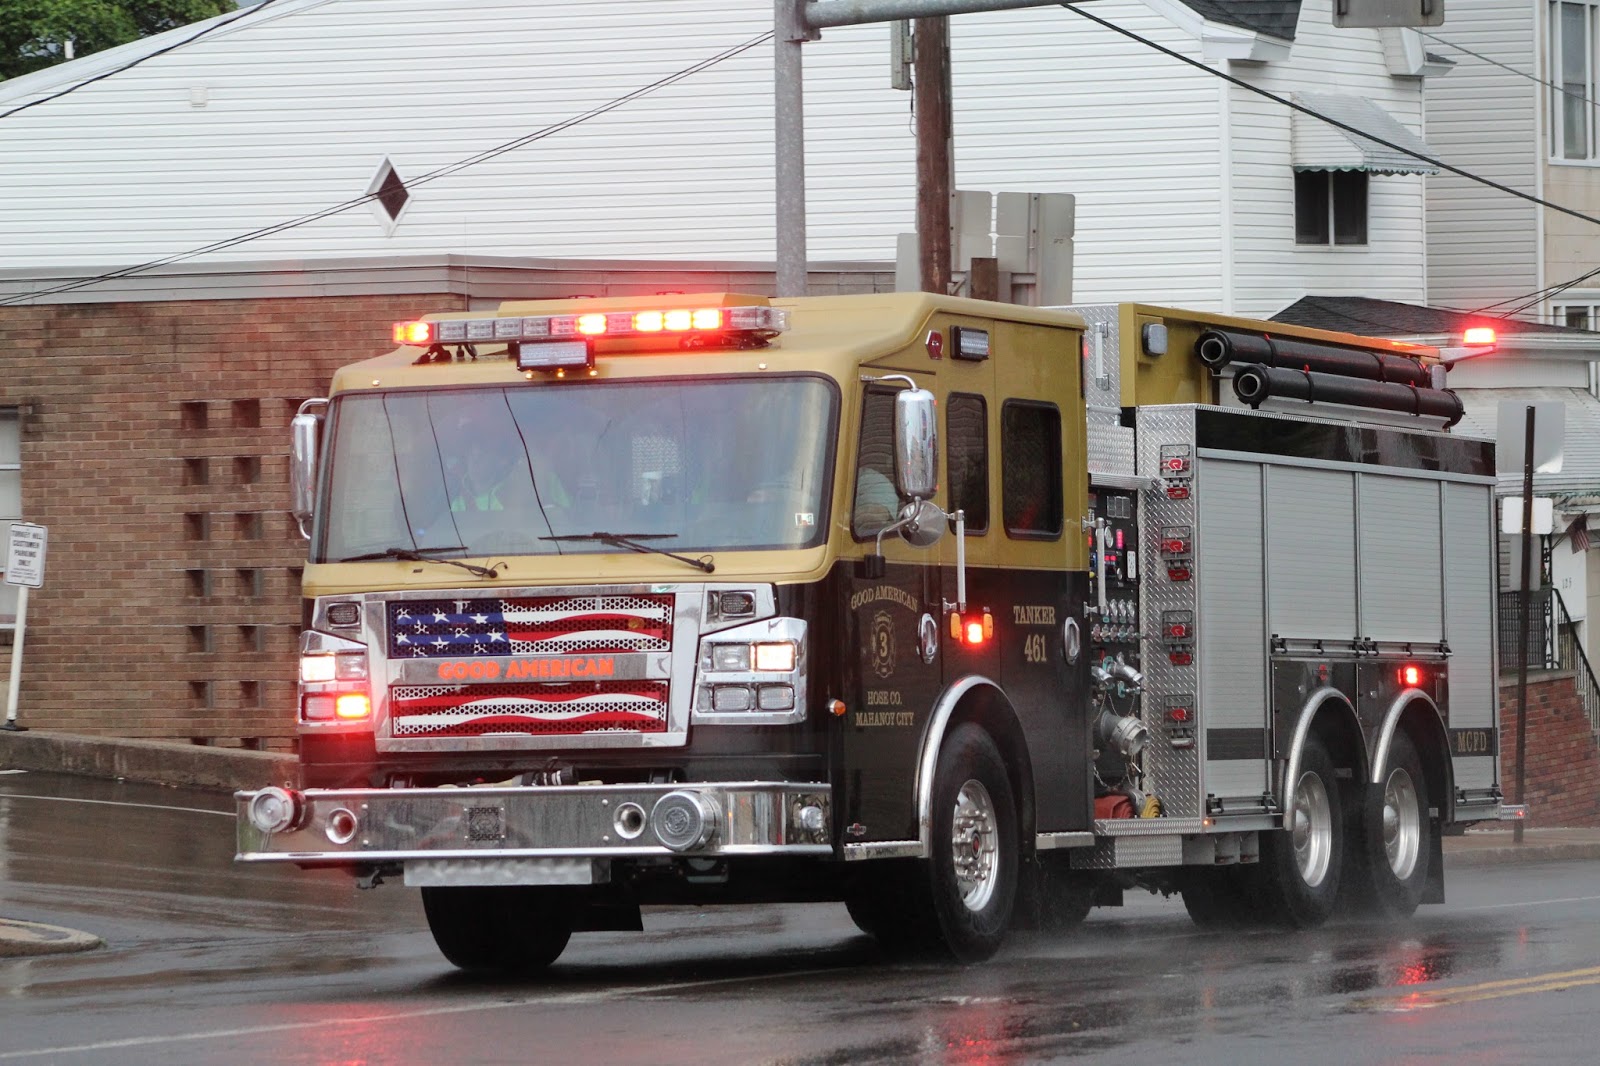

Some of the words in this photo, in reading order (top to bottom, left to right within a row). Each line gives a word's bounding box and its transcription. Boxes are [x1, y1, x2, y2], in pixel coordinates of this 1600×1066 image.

[851, 588, 874, 610] GOOD
[874, 585, 918, 613] AMERICAN
[1013, 605, 1056, 625] TANKER
[879, 632, 888, 658] 3
[1023, 634, 1047, 662] 461
[437, 661, 500, 680] GOOD
[505, 657, 615, 679] AMERICAN
[867, 691, 889, 705] HOSE
[889, 691, 902, 705] CO.
[855, 712, 895, 726] MAHANOY
[895, 711, 914, 726] CITY
[1457, 731, 1487, 752] MCFD
